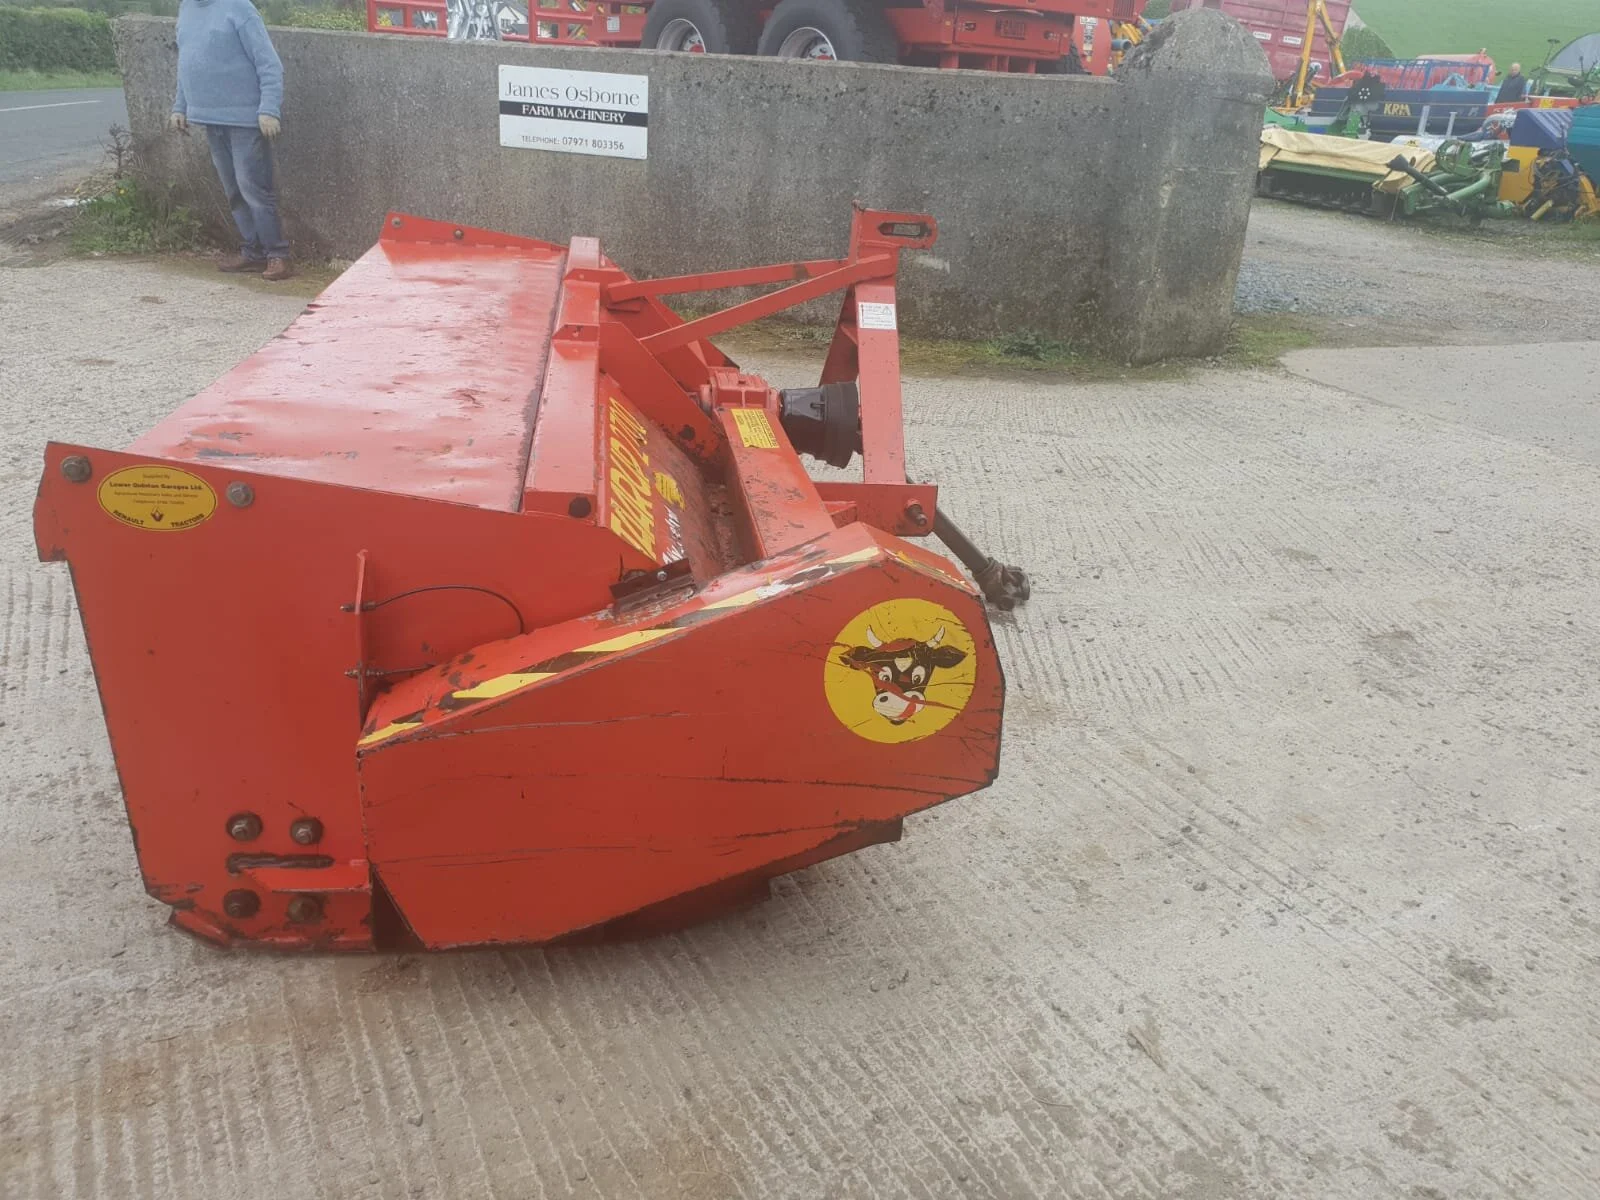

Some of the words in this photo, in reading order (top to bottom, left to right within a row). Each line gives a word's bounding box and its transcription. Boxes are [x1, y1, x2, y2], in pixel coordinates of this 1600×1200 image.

[505, 82, 559, 99] James
[565, 85, 640, 106] Osborne
[522, 104, 554, 117] FARM
[557, 106, 626, 124] MACHINERY
[1383, 103, 1411, 116] KRM
[562, 136, 588, 147] 07971
[591, 138, 625, 150] 803356
